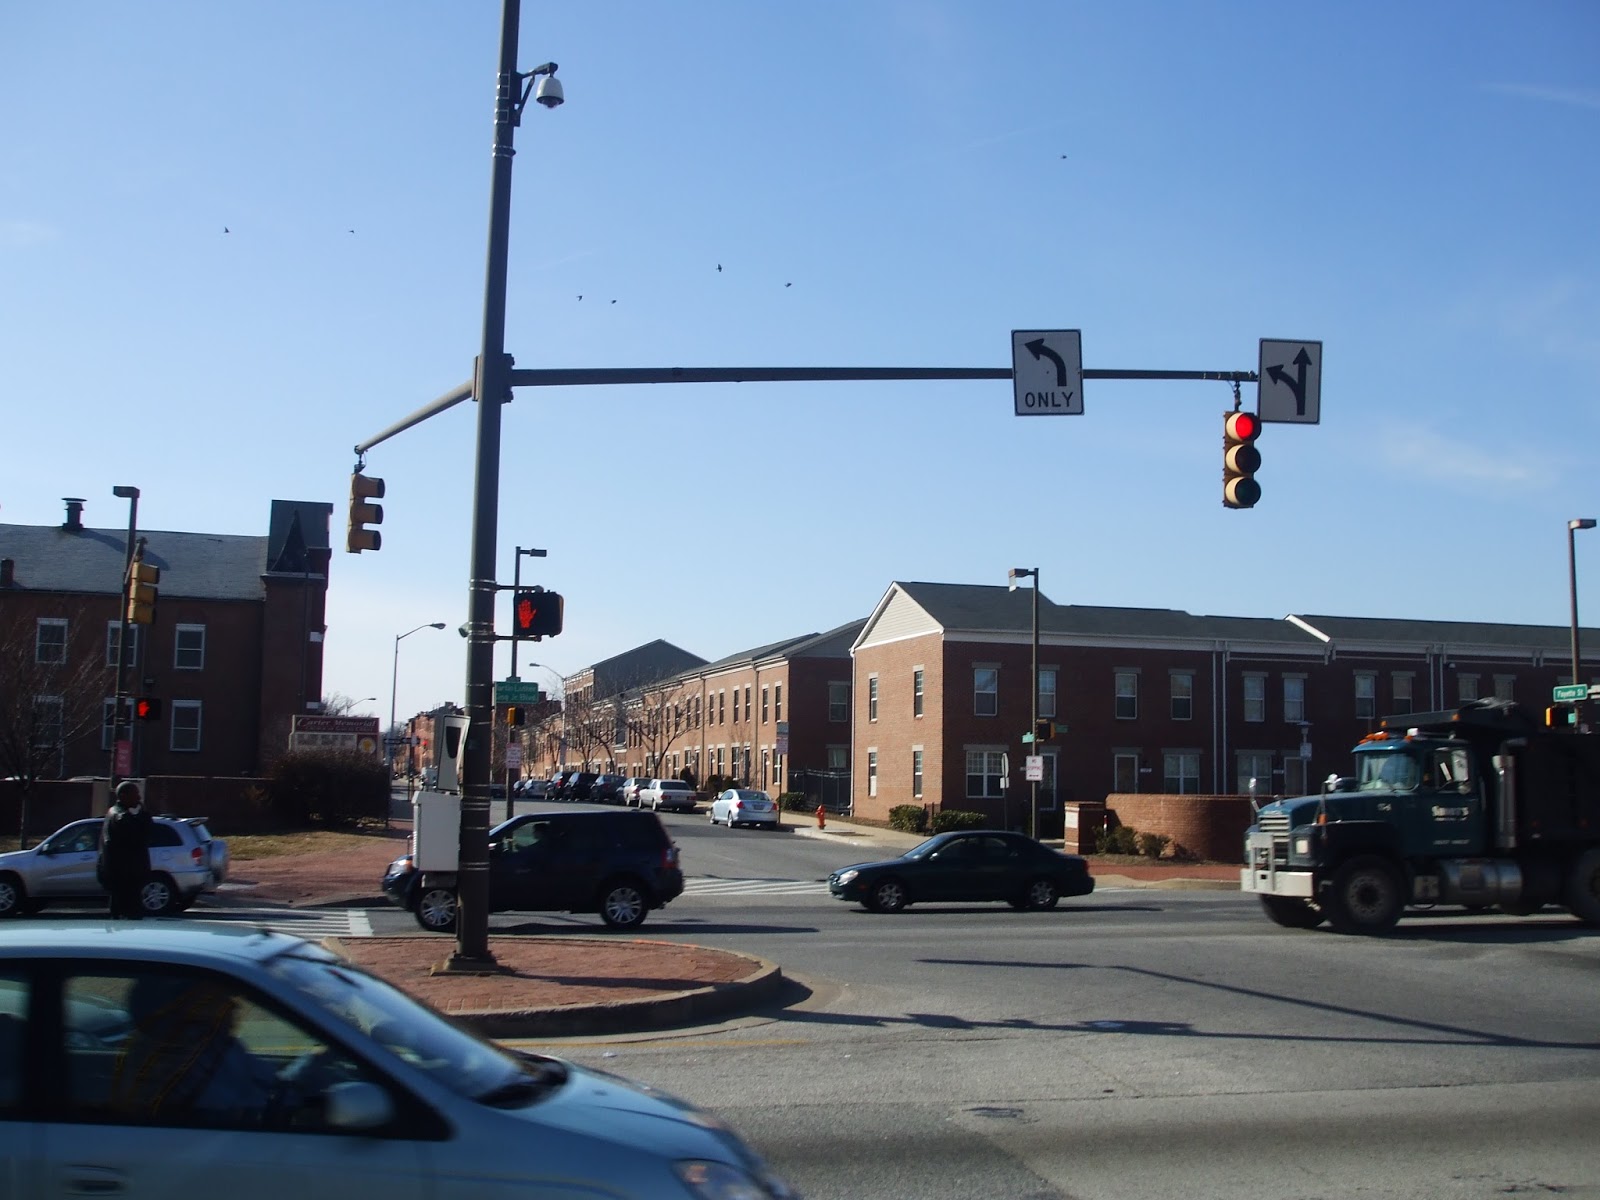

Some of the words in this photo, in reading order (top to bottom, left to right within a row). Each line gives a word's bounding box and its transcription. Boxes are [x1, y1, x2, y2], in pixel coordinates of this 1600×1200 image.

[1025, 391, 1073, 407] ONLY
[1576, 688, 1584, 696] St
[296, 718, 331, 728] Carter
[335, 719, 377, 727] Memorial
